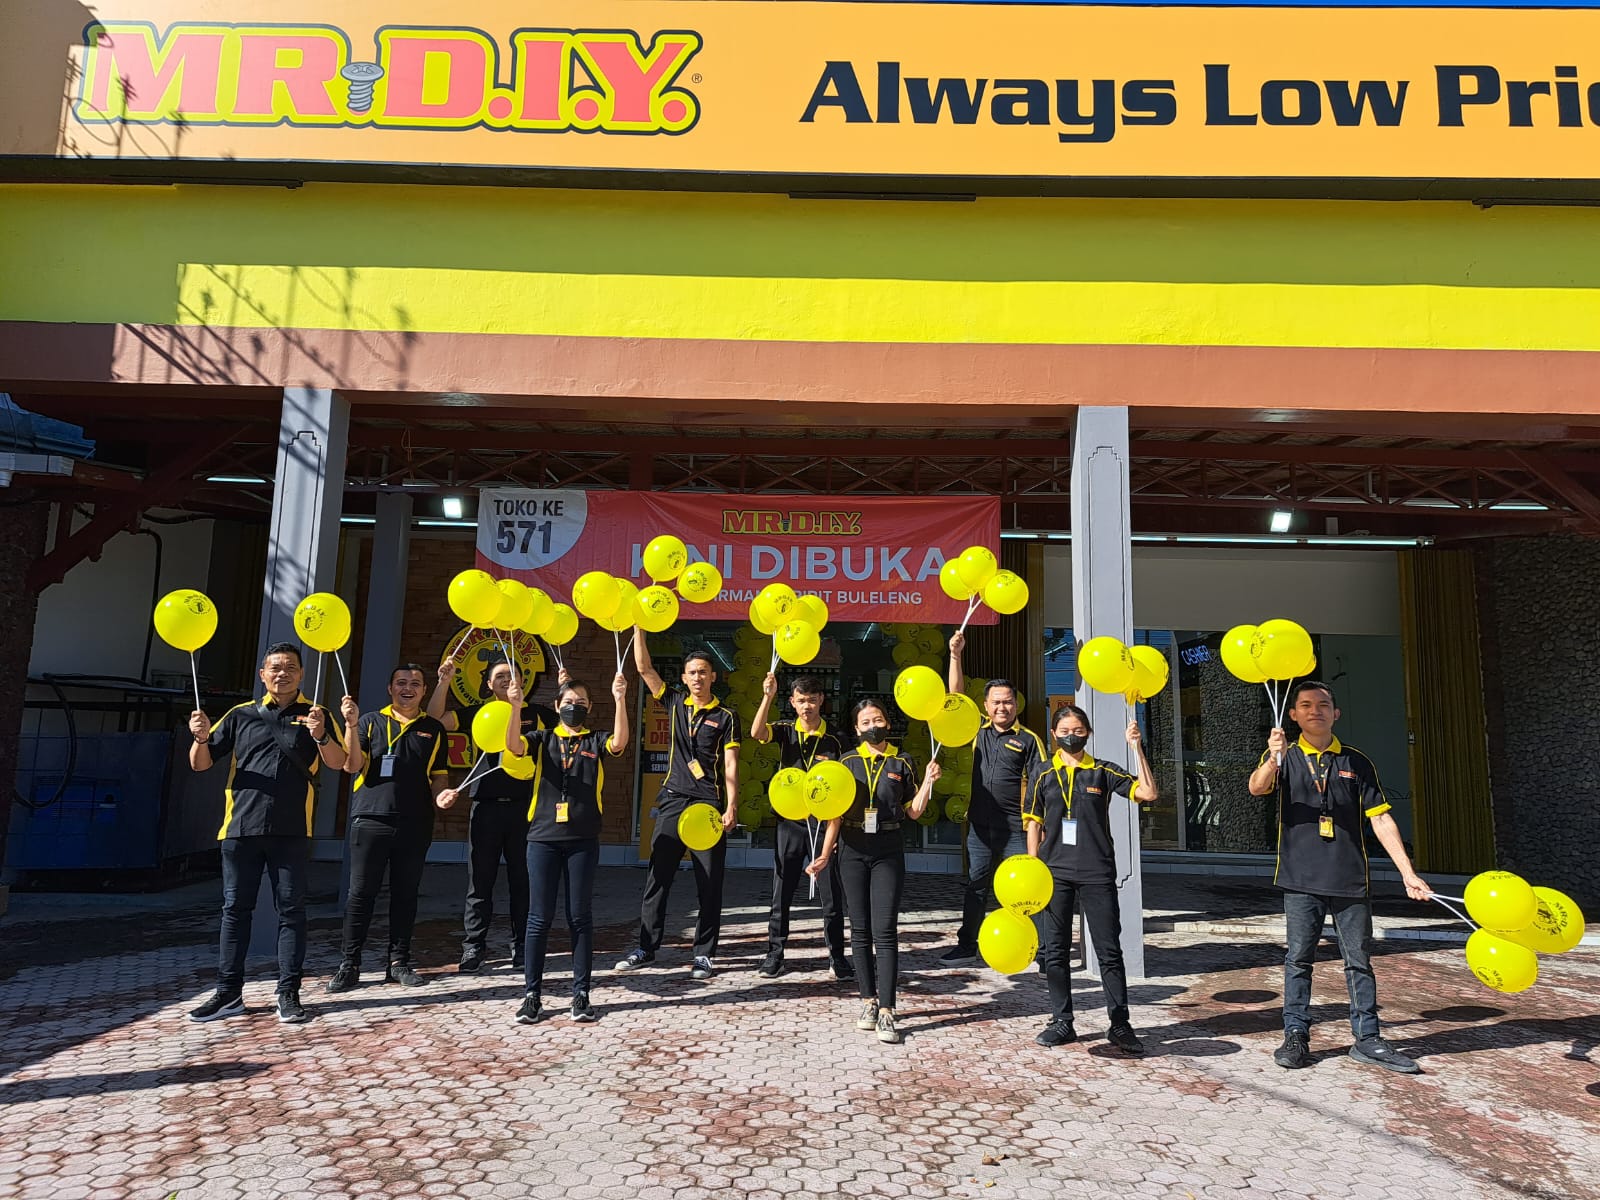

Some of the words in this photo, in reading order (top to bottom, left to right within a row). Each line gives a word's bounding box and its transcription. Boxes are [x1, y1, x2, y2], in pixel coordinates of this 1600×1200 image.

[799, 61, 1177, 143] Always
[1204, 64, 1410, 126] Low
[493, 499, 538, 516] TOKO
[542, 500, 564, 516] KE
[496, 520, 552, 554] 571
[750, 545, 949, 582] DIBUKA
[837, 590, 923, 605] BULELENG
